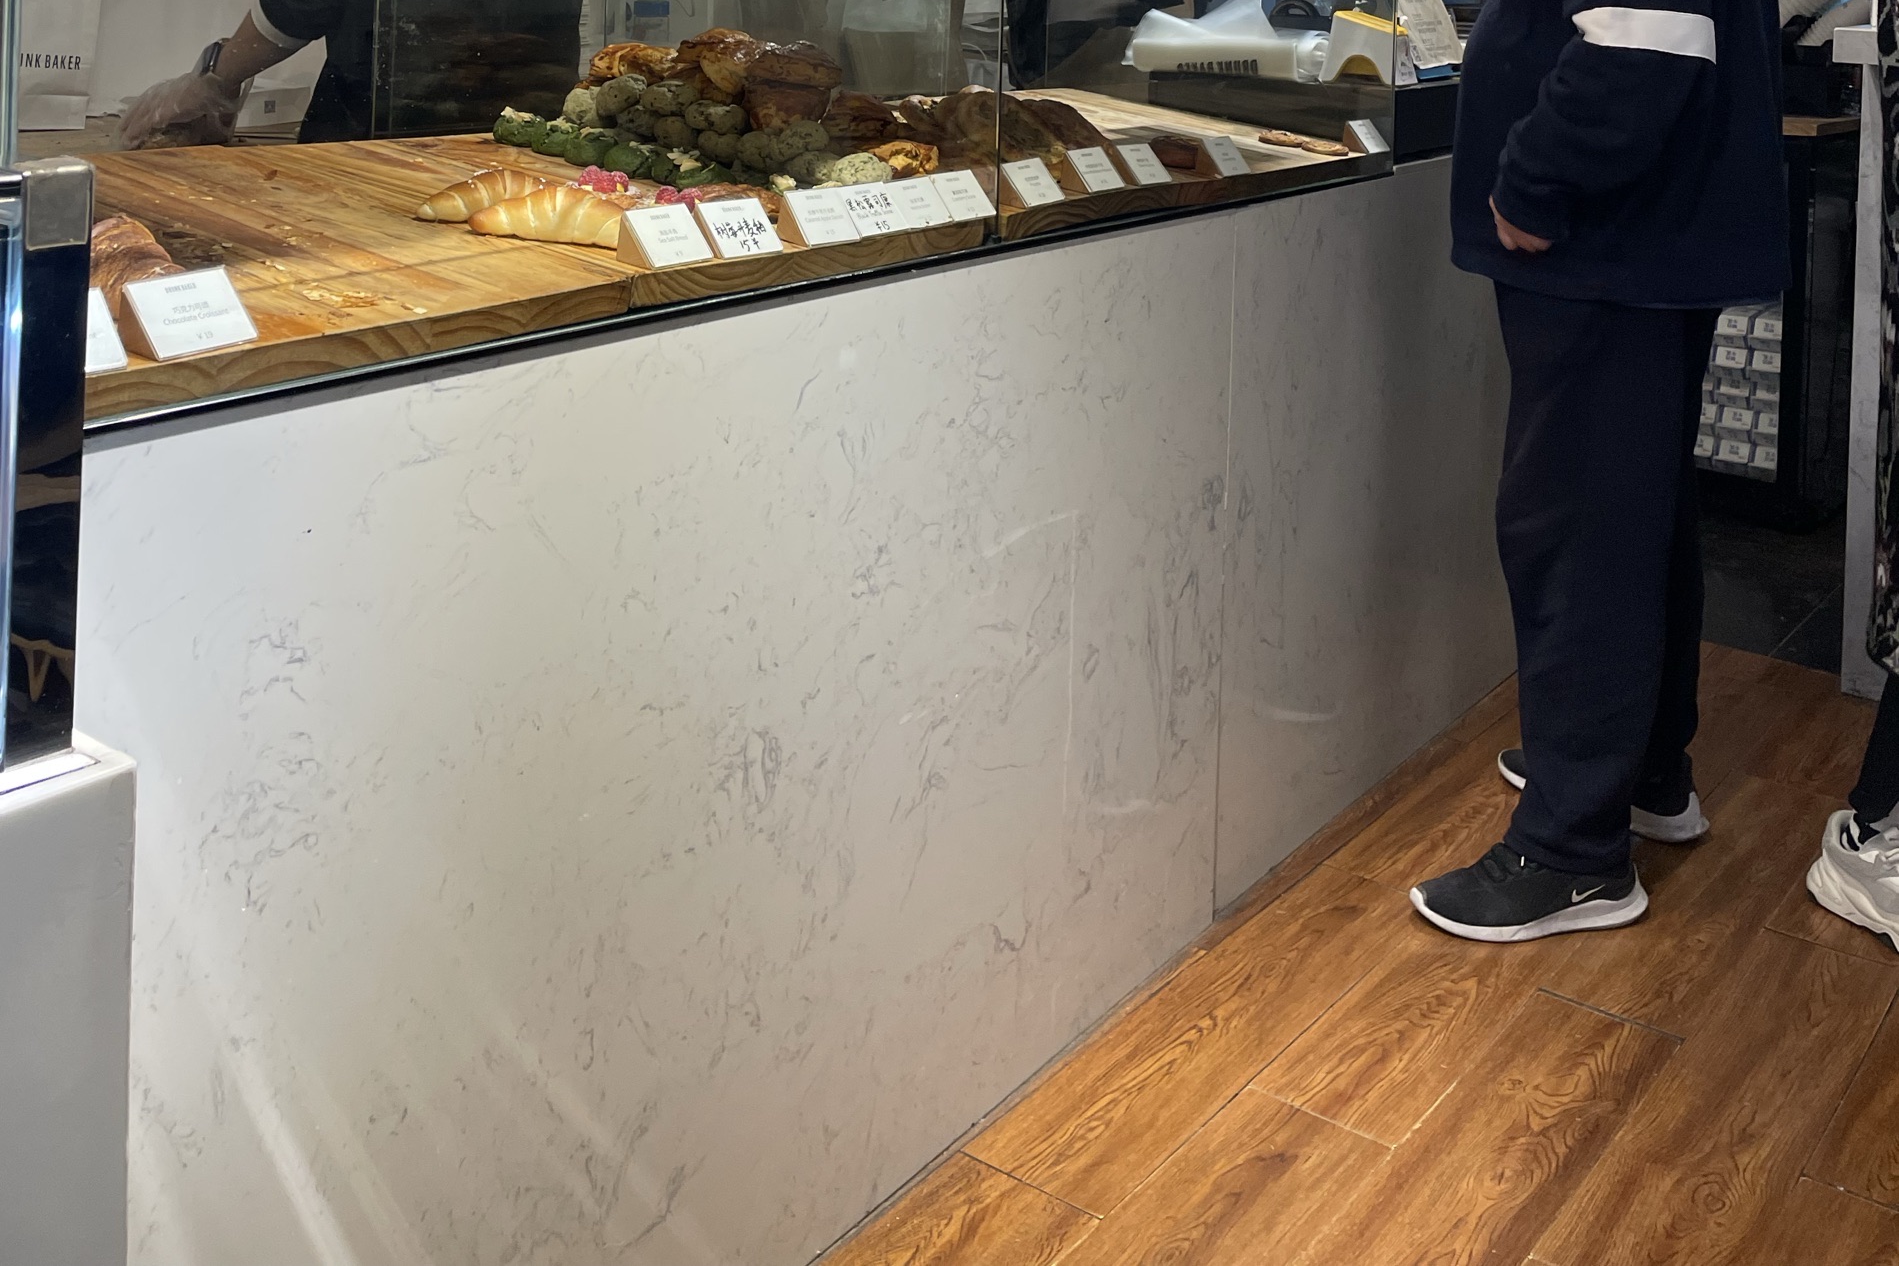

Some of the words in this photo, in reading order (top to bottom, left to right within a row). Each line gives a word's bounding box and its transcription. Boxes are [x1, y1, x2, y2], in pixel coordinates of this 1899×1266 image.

[44, 54, 81, 70] BAKER
[163, 314, 198, 326] Chocolate
[197, 308, 229, 320] Croissant
